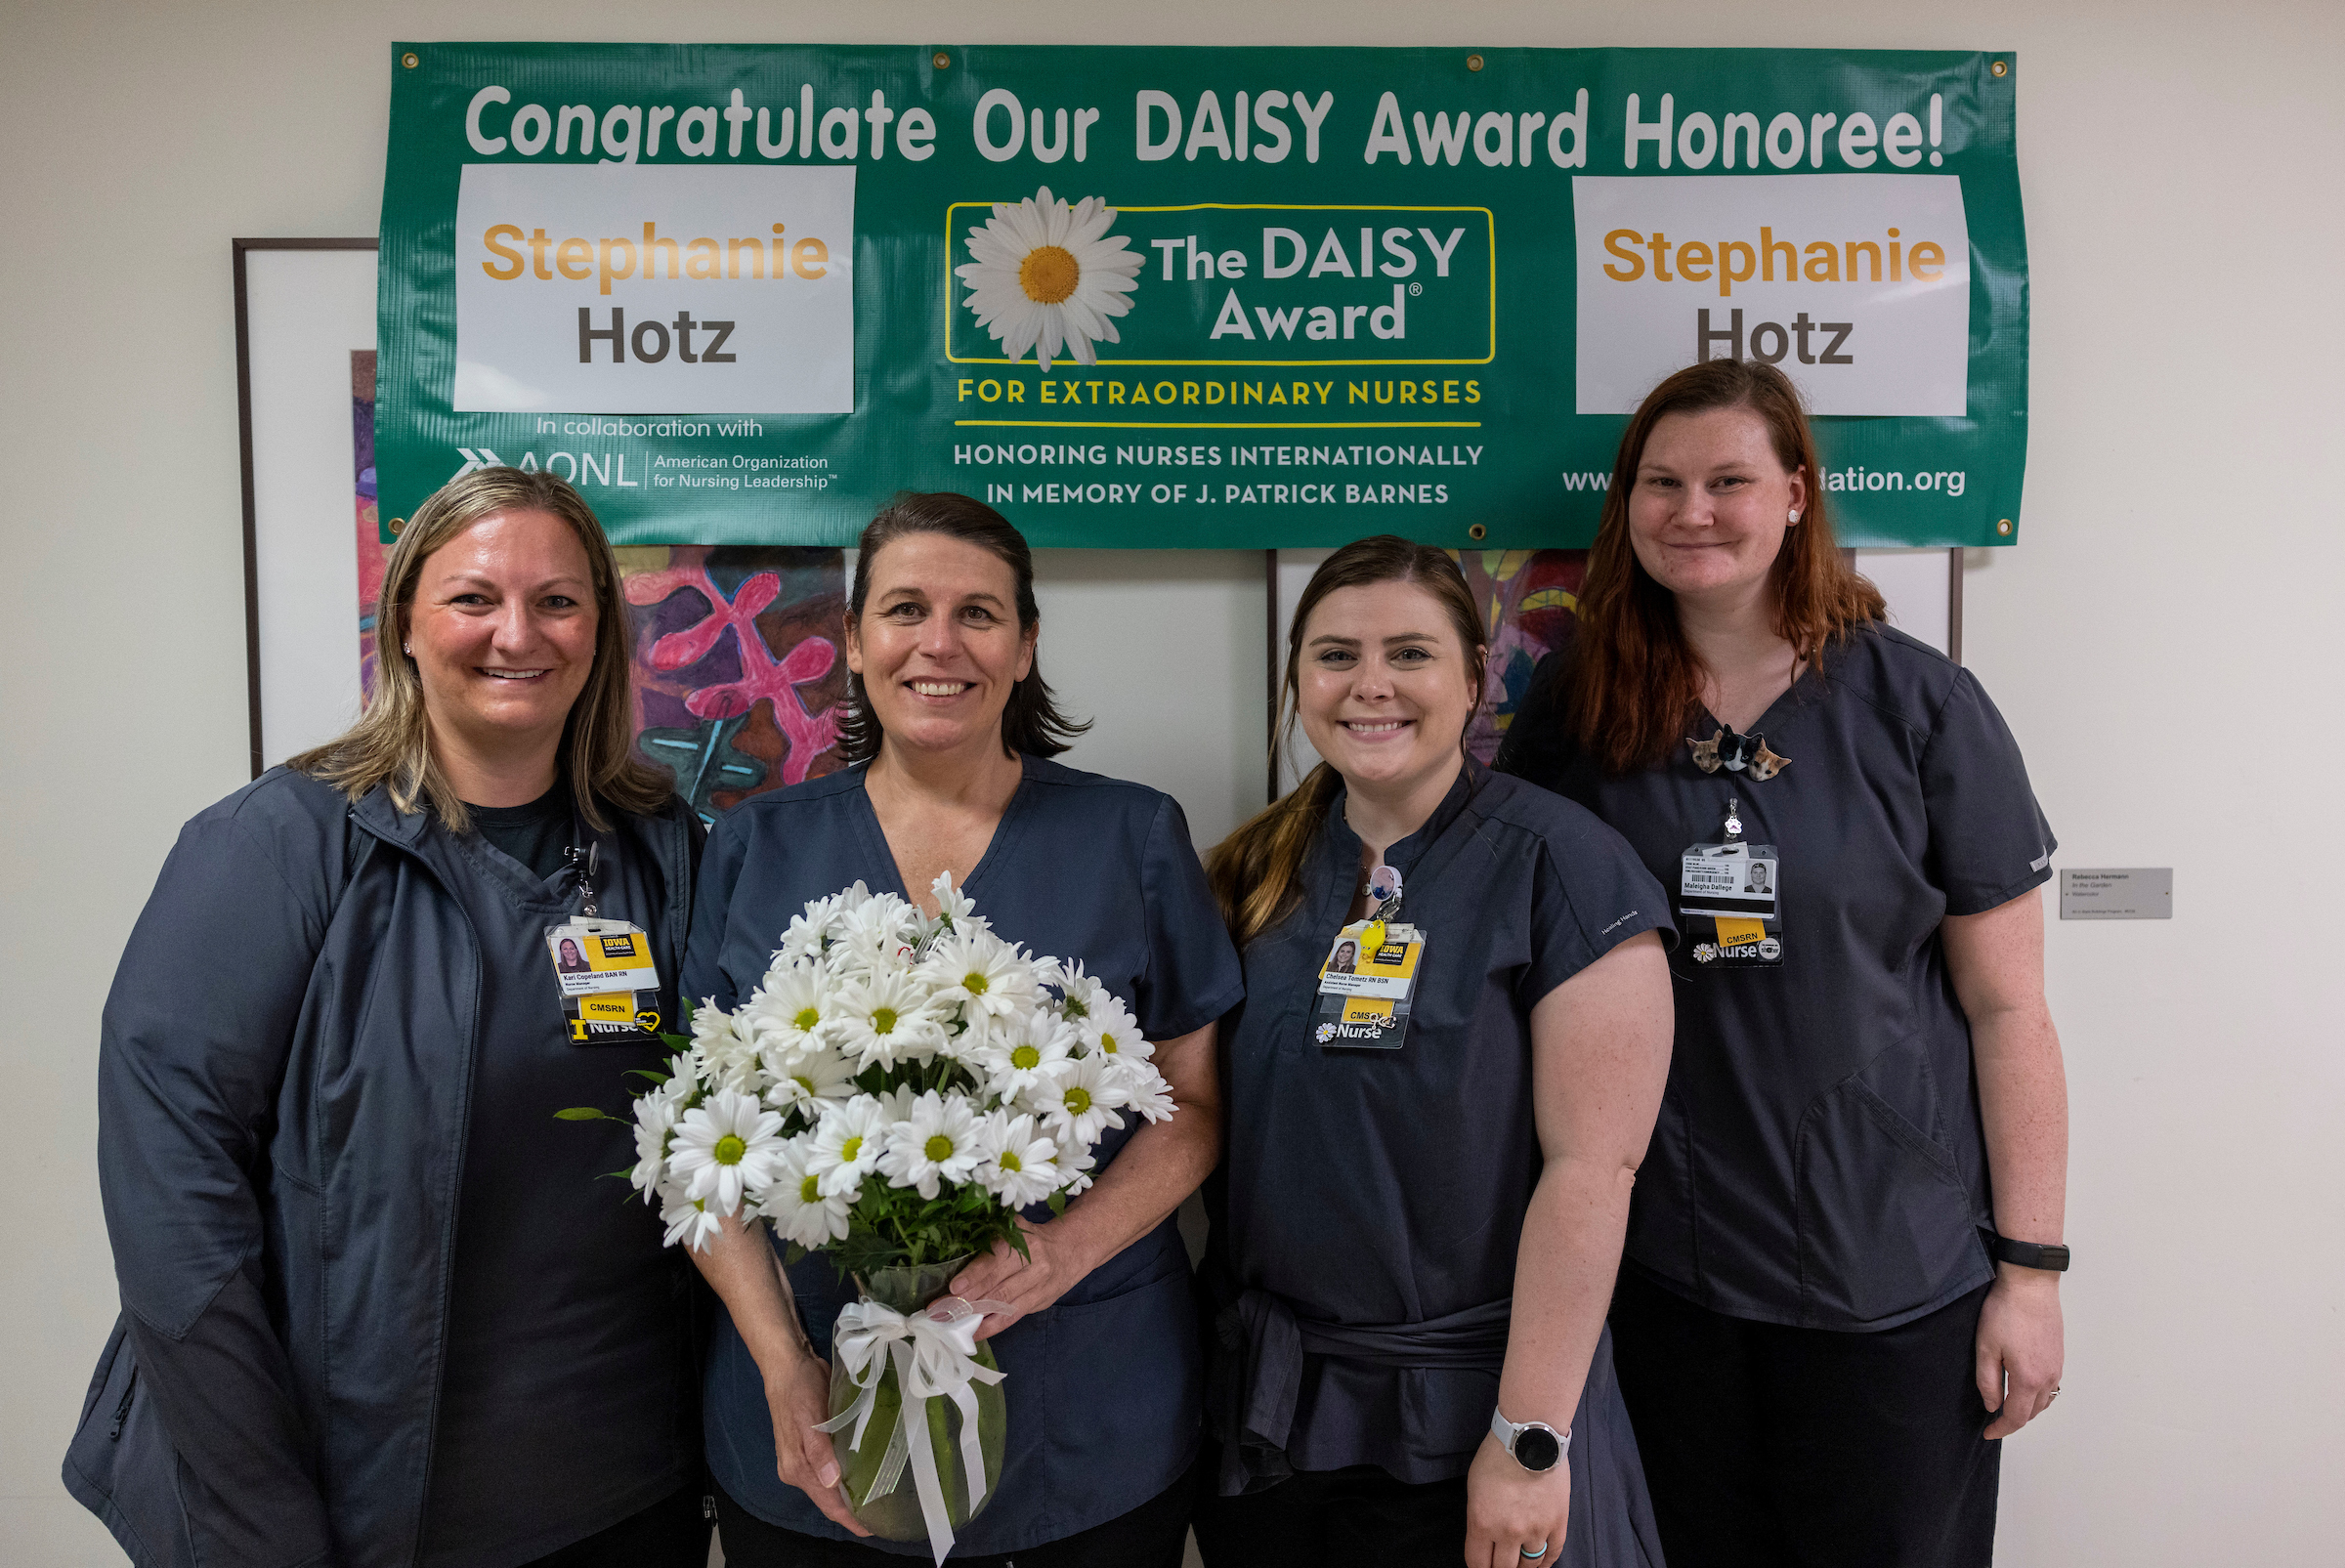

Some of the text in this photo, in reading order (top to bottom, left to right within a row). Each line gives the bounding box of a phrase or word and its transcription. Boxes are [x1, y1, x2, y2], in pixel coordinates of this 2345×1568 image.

[466, 84, 1943, 170] Congratulate Our DAISY Award Honoree!
[482, 223, 829, 295] Stephanie
[1151, 227, 1466, 281] The DAISY
[1603, 226, 1945, 297] Stephanie
[577, 308, 737, 364] Hotz
[1698, 309, 1854, 364] Hotz
[958, 379, 1481, 405] FOR EXTRAORDINARY NURSES
[537, 417, 763, 438] In collaboration with
[654, 454, 829, 474] American Organization
[955, 444, 1484, 467] HONORING NURSES INTERNATIONALLY
[519, 451, 638, 487] AONL
[654, 474, 673, 488] for
[678, 474, 739, 491] Nursing
[987, 483, 1449, 504] IN MEMORY OF J. PATRICK BARNES
[603, 937, 630, 947] IOWA
[1727, 932, 1758, 944] CMSRN
[590, 1003, 625, 1013] CMSRN
[1350, 1011, 1383, 1020] CMSN
[1337, 1024, 1383, 1039] Nurse
